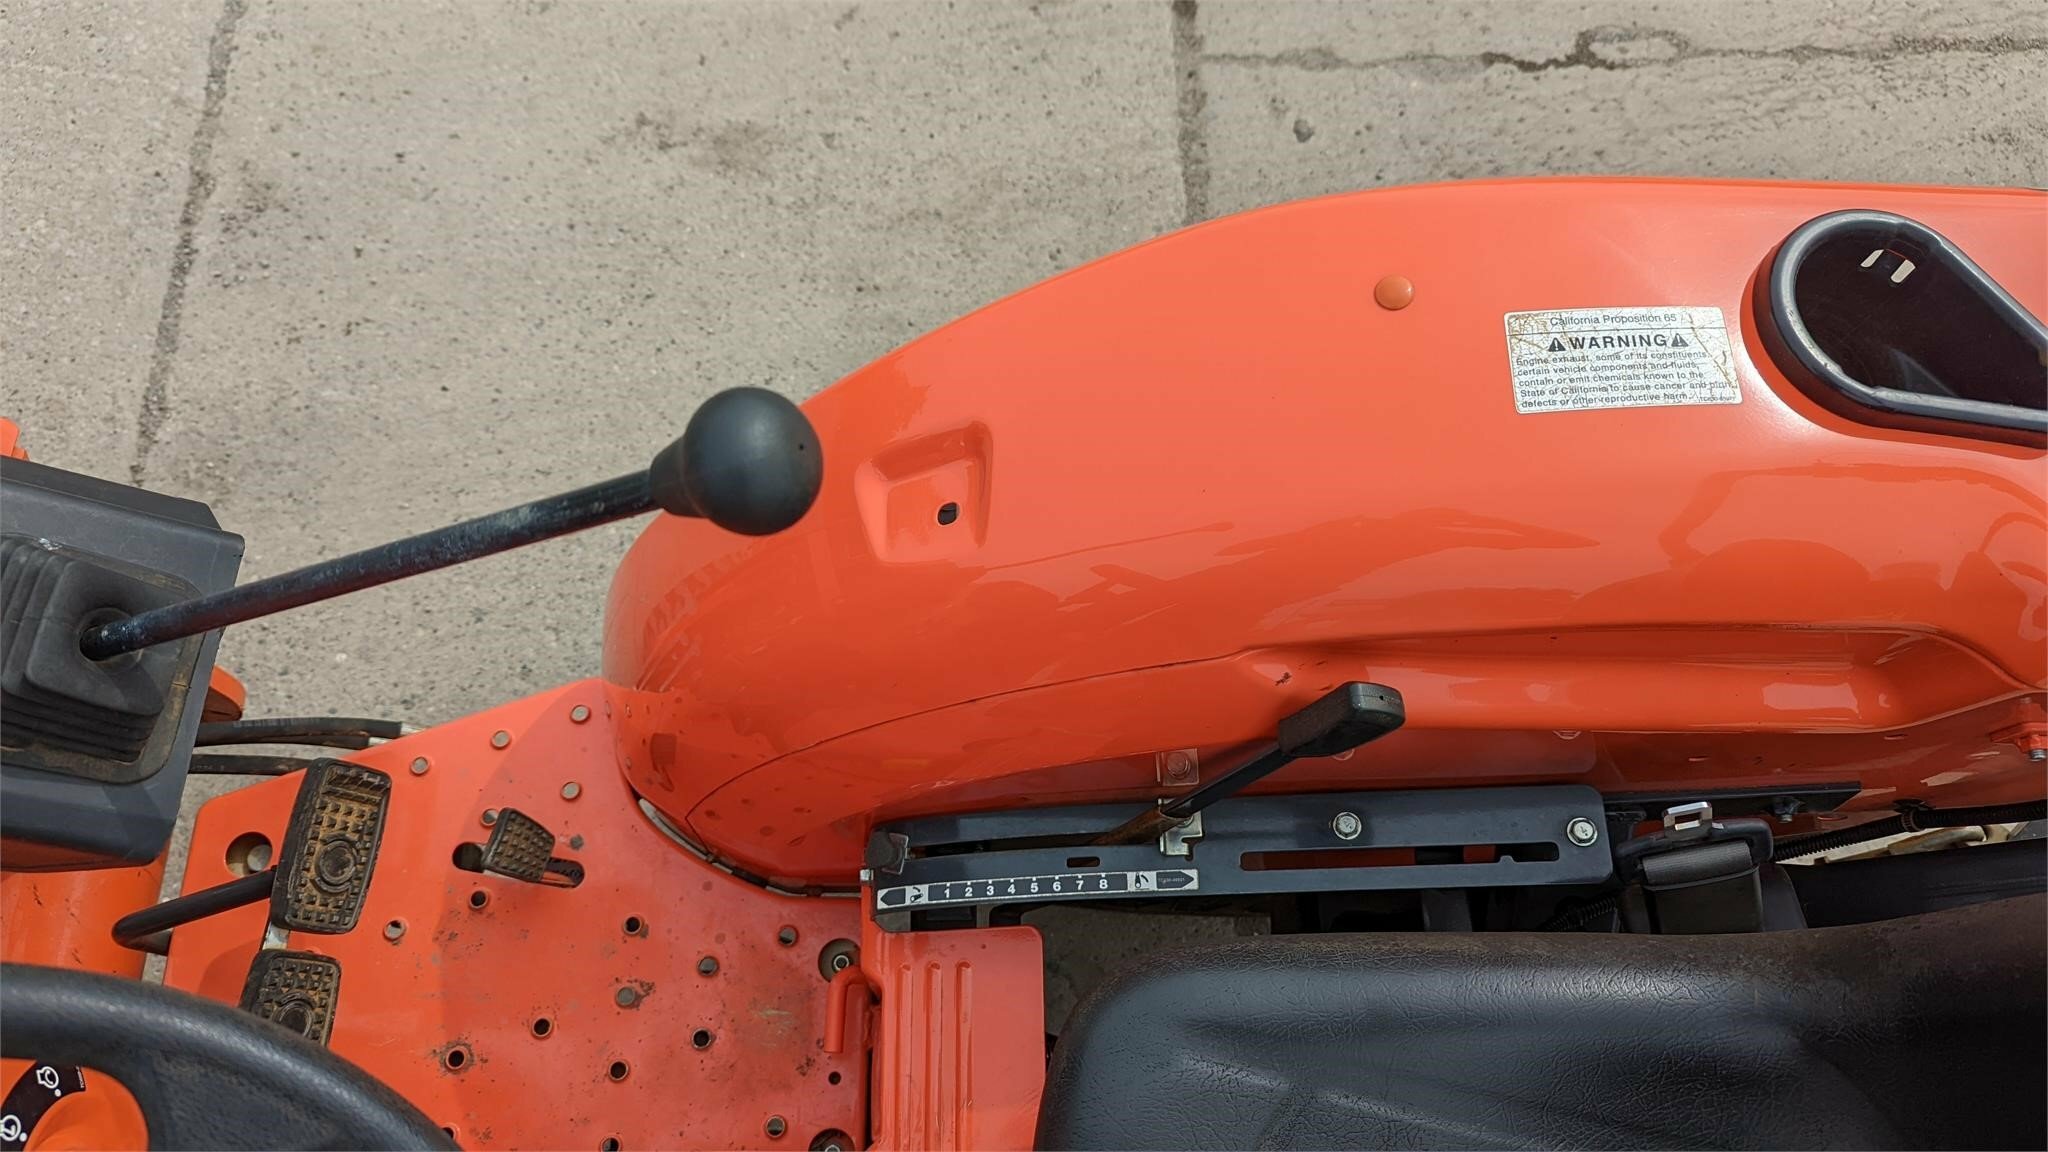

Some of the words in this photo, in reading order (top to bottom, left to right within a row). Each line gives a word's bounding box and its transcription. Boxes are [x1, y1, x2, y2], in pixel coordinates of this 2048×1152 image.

[1550, 316, 1600, 326] California
[1602, 314, 1661, 325] Proposition
[1663, 313, 1677, 322] 65
[1569, 334, 1667, 349] WARNING
[1516, 356, 1549, 367] Engine
[1596, 353, 1621, 361] some
[1624, 352, 1634, 360] of
[1517, 367, 1550, 376] certain
[1553, 365, 1587, 374] vehicle
[1590, 363, 1648, 373] components
[1650, 361, 1668, 369] and
[1518, 377, 1554, 387] contain
[1569, 375, 1590, 383] emit
[1593, 373, 1641, 382] chemicals
[1644, 371, 1674, 380] known
[1677, 371, 1687, 379] to
[1689, 370, 1704, 378] the
[1520, 388, 1546, 397] State
[1548, 387, 1559, 396] of
[1561, 385, 1608, 395] California
[1610, 384, 1620, 392] to
[1654, 382, 1686, 390] cancer
[1521, 399, 1557, 408] defects
[1560, 399, 1570, 407] or
[1572, 396, 1597, 404] other
[1601, 393, 1660, 404] reproductive
[944, 889, 951, 898] 1
[964, 887, 973, 897] 2
[986, 885, 995, 895] 3
[1007, 884, 1016, 894] 4
[1030, 882, 1039, 893] 5
[1053, 881, 1062, 891] 6
[1076, 880, 1084, 890] 7
[1099, 879, 1108, 889] 8
